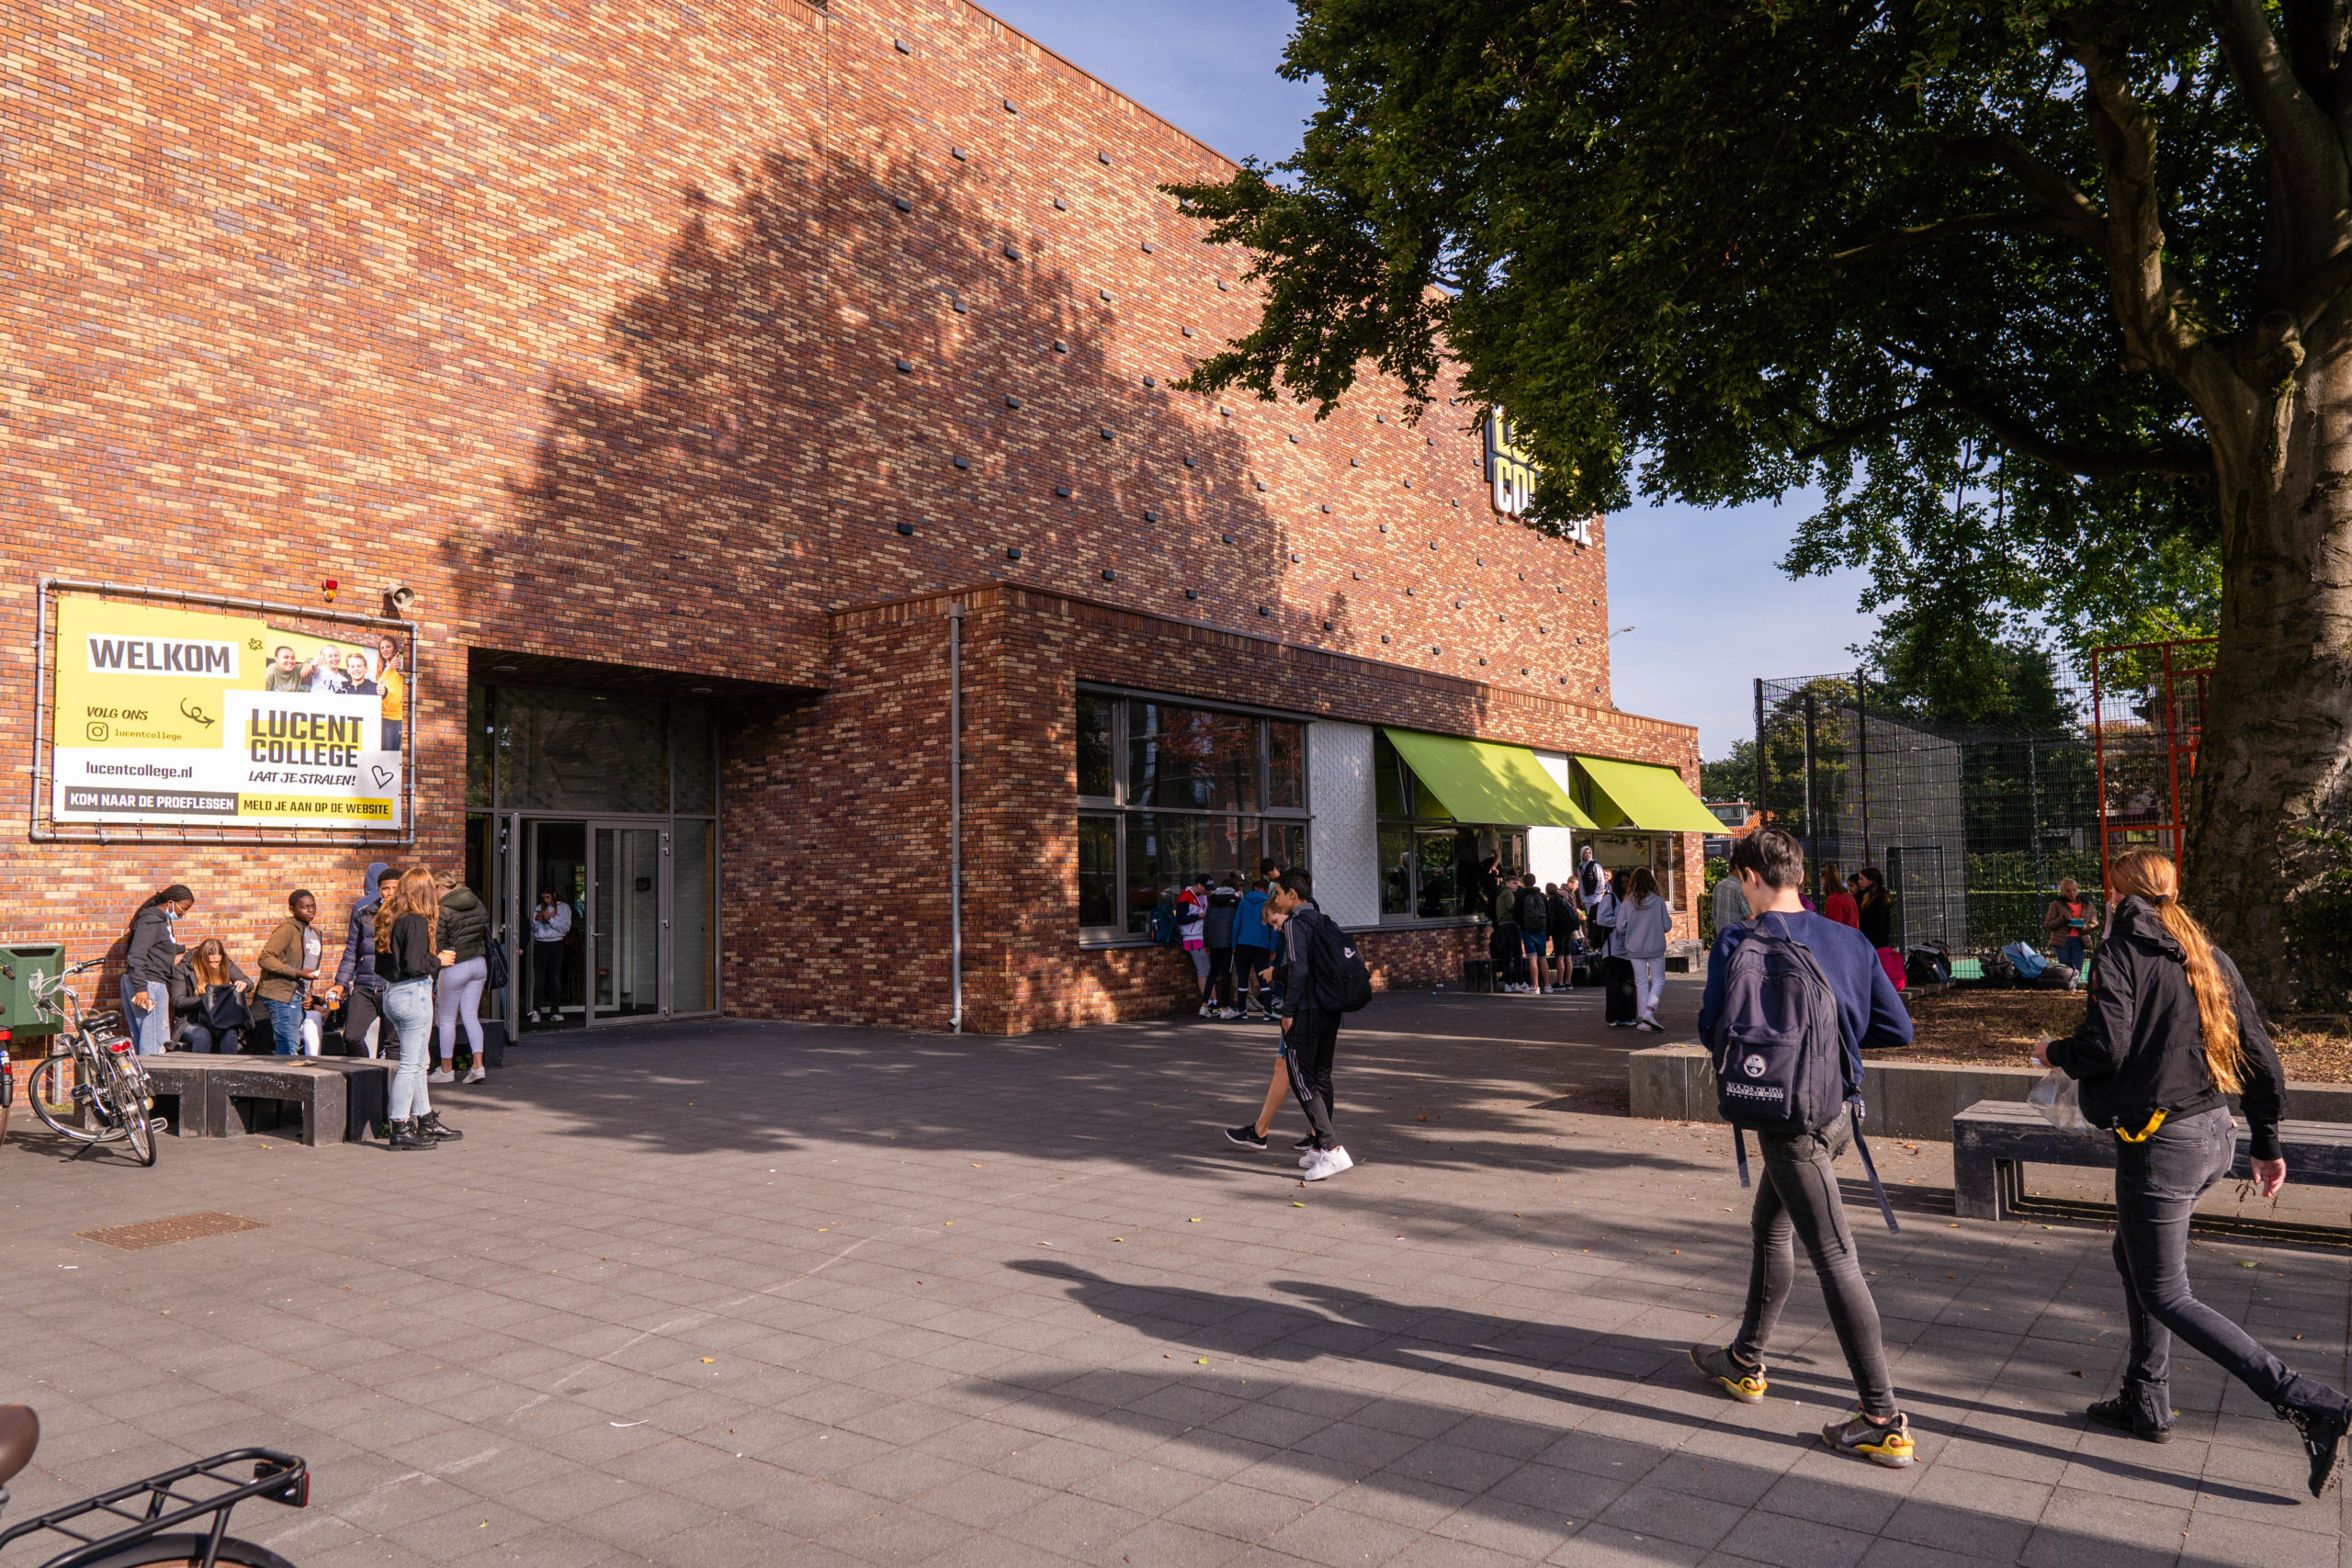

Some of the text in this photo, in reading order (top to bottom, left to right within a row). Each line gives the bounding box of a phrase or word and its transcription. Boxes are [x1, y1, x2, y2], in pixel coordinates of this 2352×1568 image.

[89, 638, 230, 673] WELKOM
[86, 705, 148, 721] VOLG ONS
[114, 728, 182, 740] lucentcollege
[252, 708, 363, 743] LUCENT
[251, 739, 357, 768] COLLEGE
[85, 761, 192, 779] lucentcollege.nl
[248, 771, 356, 786] LAAT JE STRALEN!
[70, 793, 234, 810] KOM NAAR DE PROEFLESSEN
[243, 800, 390, 815] MELD JE AAN OP DE WEBSITE
